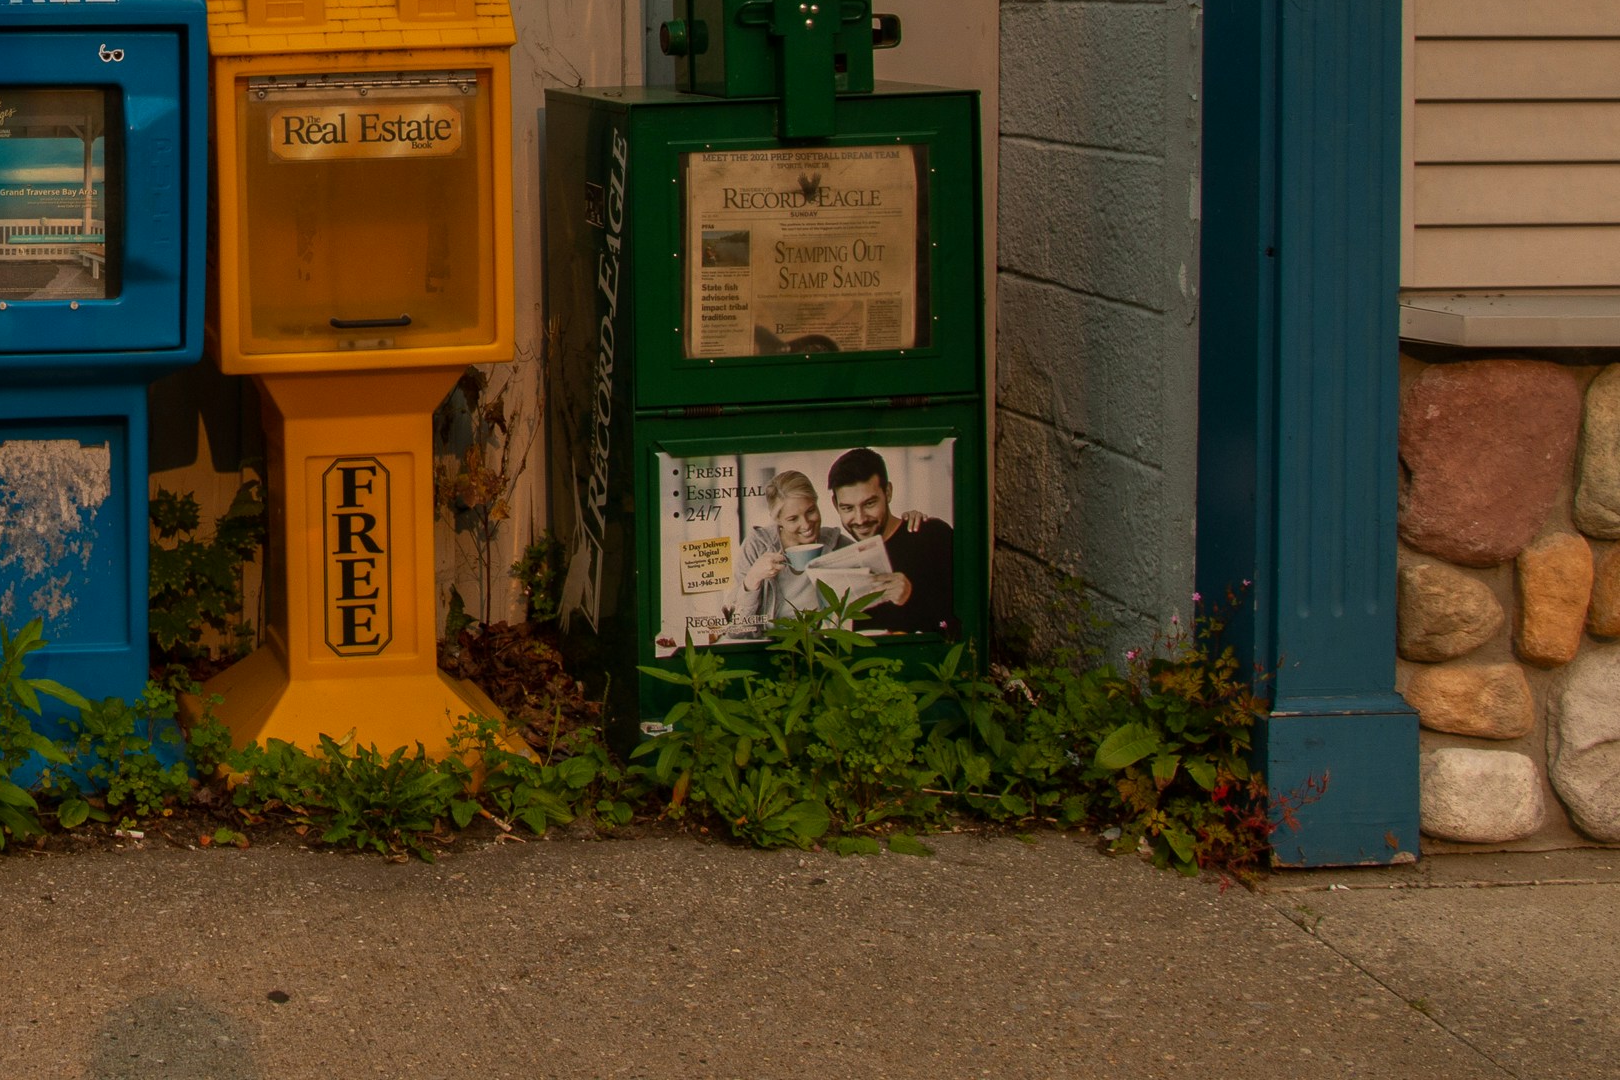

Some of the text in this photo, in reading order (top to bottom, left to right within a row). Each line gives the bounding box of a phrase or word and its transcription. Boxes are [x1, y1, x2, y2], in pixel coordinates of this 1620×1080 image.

[307, 116, 320, 124] The
[282, 113, 452, 145] Real Estate
[412, 141, 433, 149] Book
[702, 154, 728, 162] MEET
[750, 153, 768, 161] 2021
[770, 153, 793, 161] PREP
[841, 152, 873, 160] DREAM
[874, 151, 900, 159] TEAM
[0, 188, 97, 198] Grand Traverse Bay Area
[722, 186, 882, 208] RECORD EAGLE
[775, 239, 885, 264] STAMPING OUT
[779, 265, 880, 289] STAMP SANDS
[701, 304, 726, 312] impact
[686, 464, 734, 479] FRESH
[686, 485, 765, 500] ESSENTIAL
[686, 506, 722, 522] 24/7
[688, 544, 700, 552] Day
[703, 540, 728, 549] Delivery
[332, 466, 384, 647] FREE
[698, 549, 720, 557] Digital
[707, 557, 728, 565] $17.99
[687, 577, 729, 588] 231-946-2187
[686, 614, 768, 628] RECORD EAGLE
